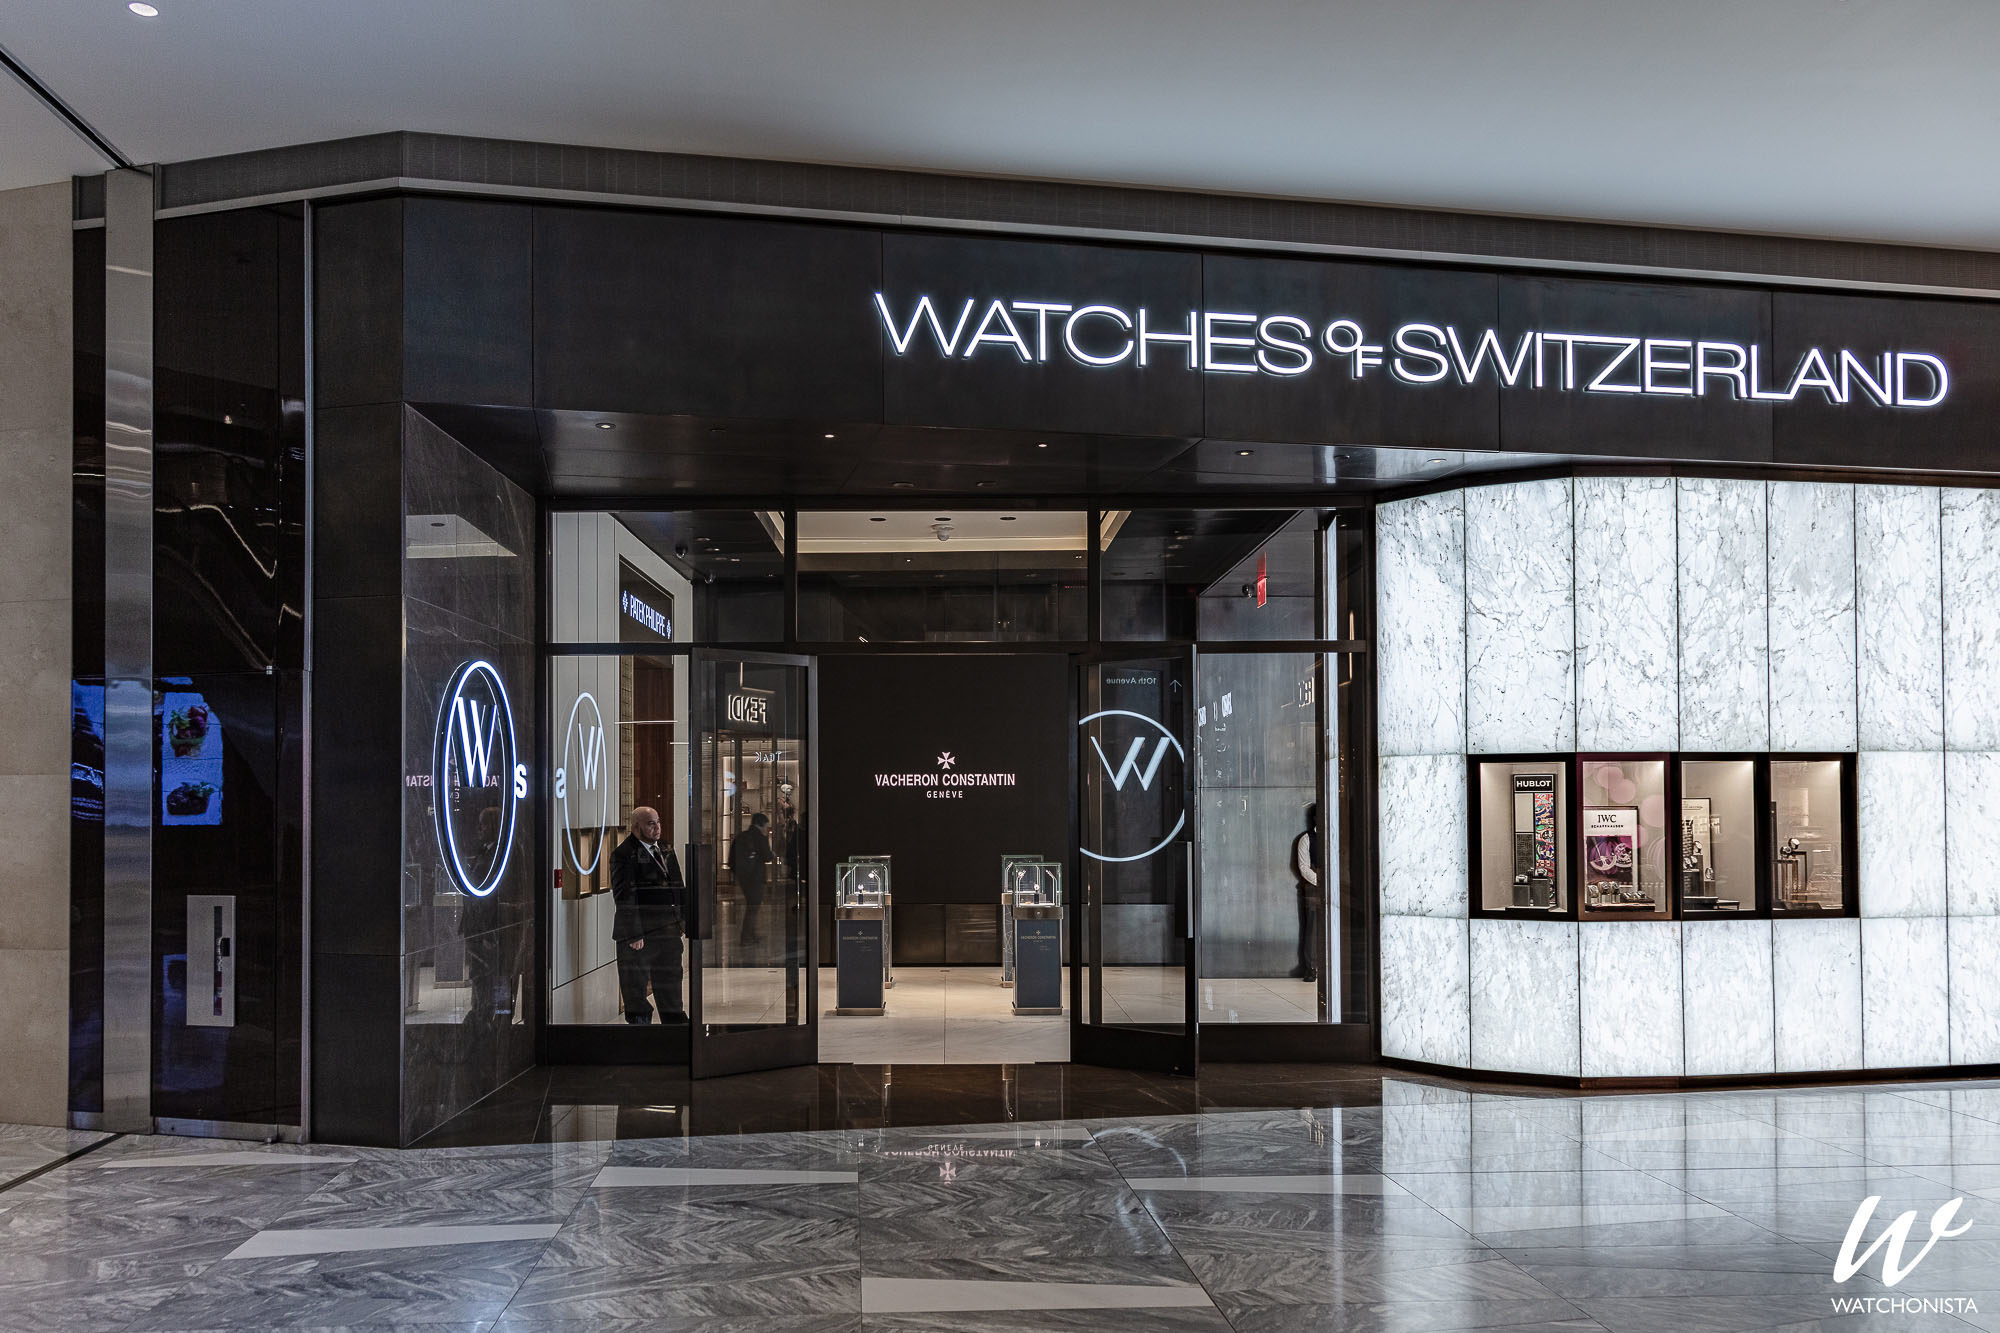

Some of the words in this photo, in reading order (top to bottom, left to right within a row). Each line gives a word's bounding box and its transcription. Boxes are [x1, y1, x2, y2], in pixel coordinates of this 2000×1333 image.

[874, 291, 1314, 375] WATCHES
[1392, 322, 1950, 408] SWITZERLAND
[874, 773, 939, 787] VACHERON
[942, 773, 1016, 786] CONSTANTIN
[1516, 779, 1551, 788] HUBLOT
[1597, 814, 1617, 824] IWC
